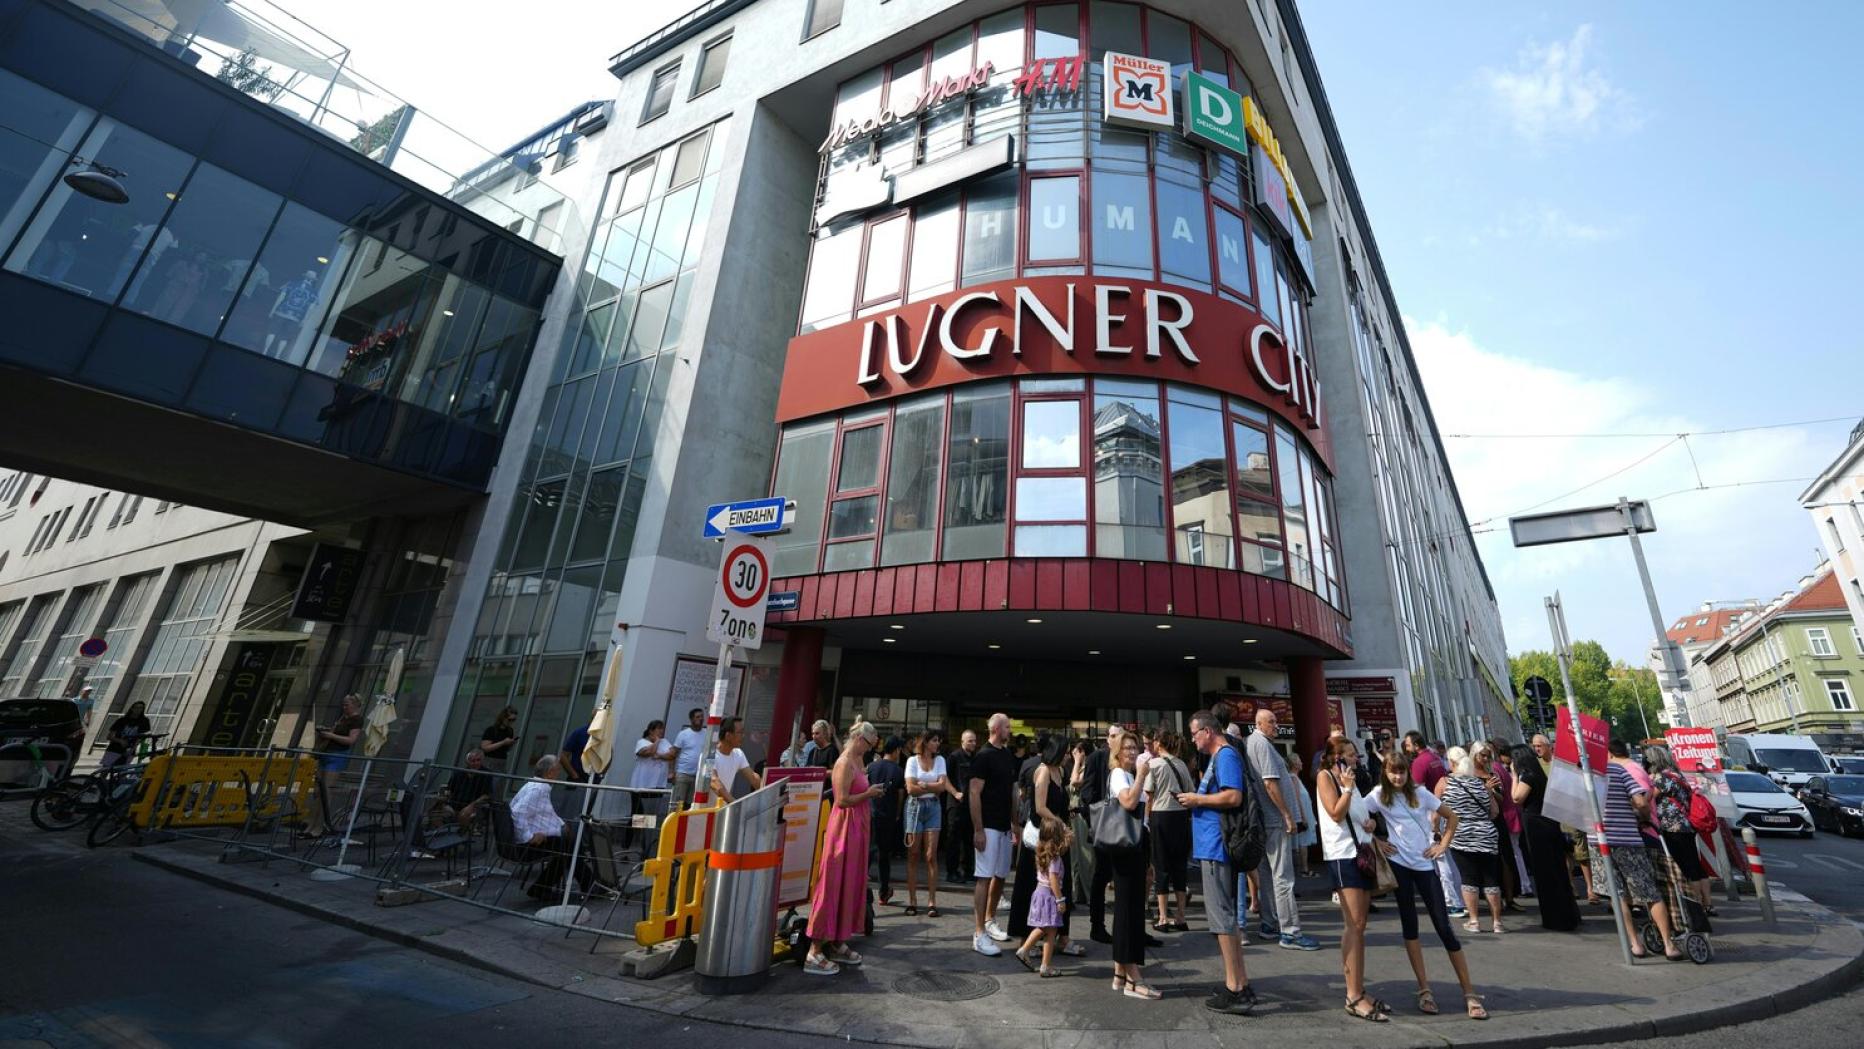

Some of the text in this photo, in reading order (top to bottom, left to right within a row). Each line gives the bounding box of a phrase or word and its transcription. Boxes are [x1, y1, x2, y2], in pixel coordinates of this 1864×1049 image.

[1113, 55, 1164, 73] Müller
[915, 60, 994, 113] Markt
[1126, 79, 1154, 102] M
[1199, 85, 1233, 127] D
[1196, 117, 1240, 143] DEICHMANN
[856, 283, 1200, 386] LUGNER
[729, 507, 775, 526] EINBAHN
[734, 560, 757, 591] 30
[1567, 722, 1606, 743] KRIER
[1672, 732, 1714, 745] Kronen
